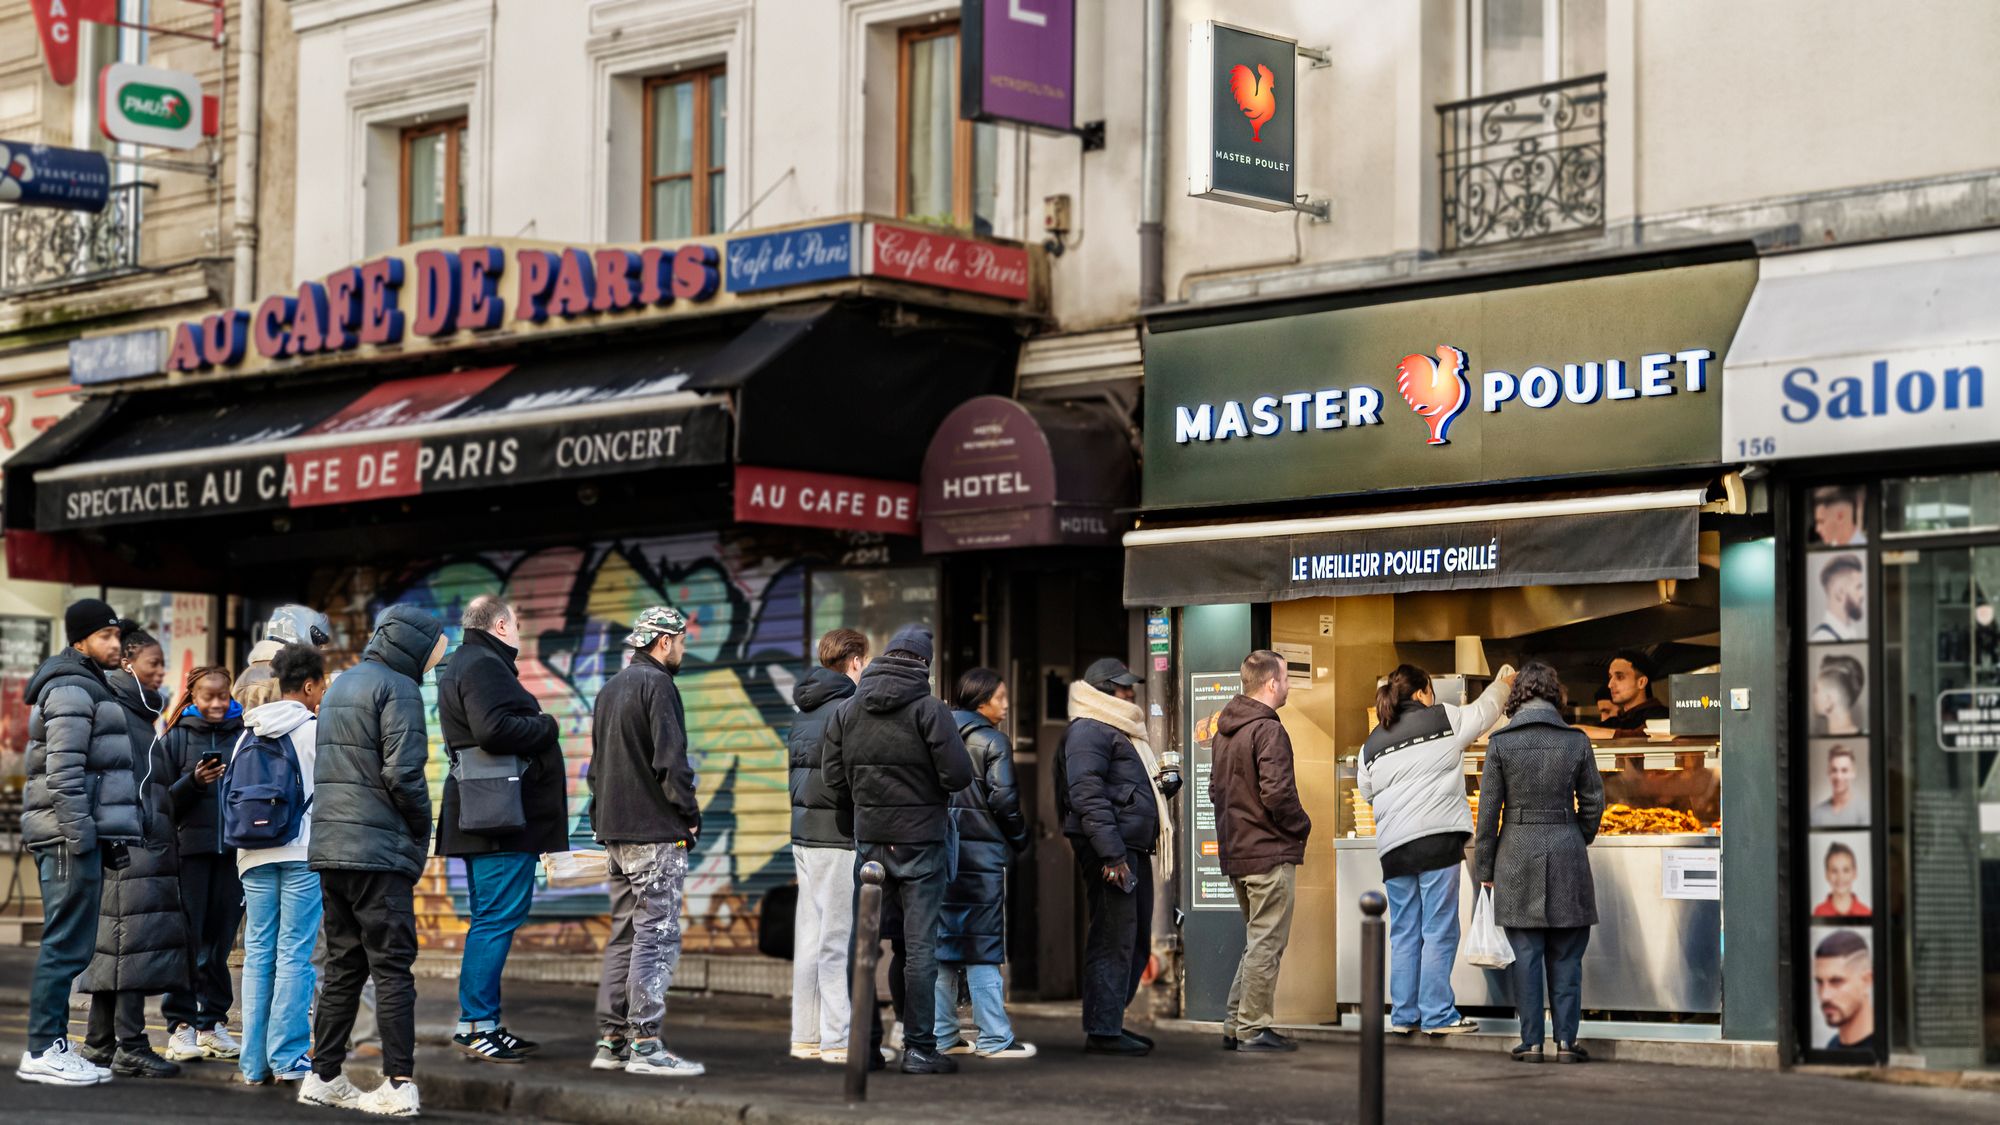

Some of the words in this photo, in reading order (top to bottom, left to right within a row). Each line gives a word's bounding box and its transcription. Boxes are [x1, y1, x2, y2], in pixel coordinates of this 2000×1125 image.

[124, 96, 159, 116] PMU
[1215, 150, 1251, 165] MASTER
[1255, 157, 1290, 172] POULET
[728, 241, 768, 285] Café
[772, 236, 792, 273] de
[797, 230, 850, 269] Paris
[875, 224, 929, 277] Café
[934, 244, 959, 273] de
[964, 246, 1026, 287] Paris
[167, 309, 250, 371] AU
[255, 256, 404, 359] CAFE
[413, 247, 504, 338] DE
[516, 244, 721, 324] PARIS
[1176, 386, 1383, 444] MASTER
[1483, 349, 1715, 412] POULET
[1781, 360, 1984, 424] Salon
[1738, 437, 1776, 457] 156
[67, 481, 189, 520] SPECTACLE
[200, 470, 242, 506] AU
[256, 457, 342, 500] CAFE
[356, 451, 399, 489] DE
[416, 437, 519, 482] PARIS
[556, 425, 683, 468] CONCERT
[943, 471, 1030, 499] HOTEL
[750, 483, 786, 508] AU
[799, 488, 865, 516] CAFE
[876, 495, 909, 520] DE
[1060, 518, 1107, 533] HOTEL
[1292, 556, 1308, 581] LE
[1312, 553, 1379, 580] MEILLEUR
[1384, 548, 1441, 576] POULET
[1444, 537, 1497, 572] GRILLÉ
[1676, 699, 1702, 708] MASTER
